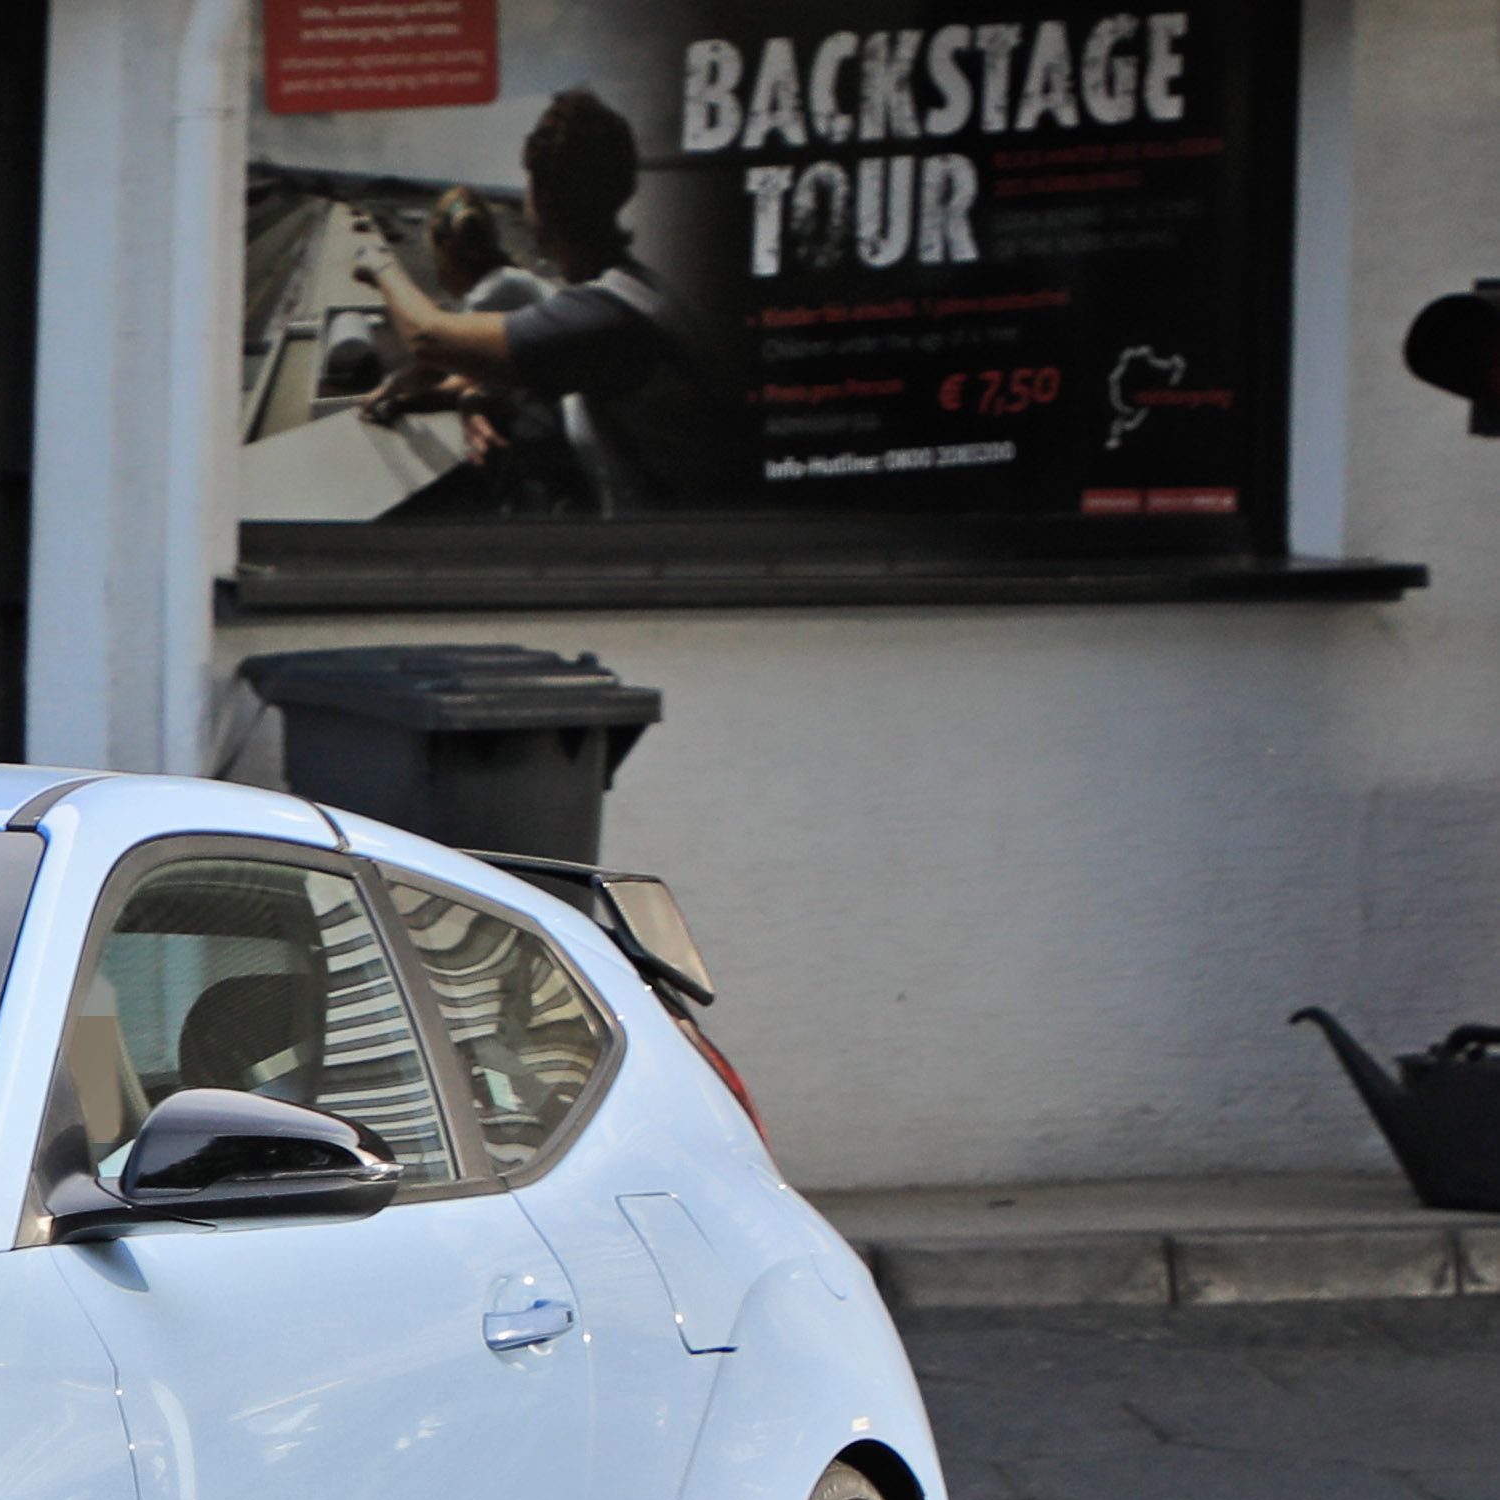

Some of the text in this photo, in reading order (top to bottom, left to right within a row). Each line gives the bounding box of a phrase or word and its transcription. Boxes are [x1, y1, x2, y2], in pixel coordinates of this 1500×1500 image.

[681, 13, 1189, 152] BACKSTAGE
[746, 153, 980, 278] TOUR
[939, 372, 968, 411] €
[977, 366, 1062, 416] 7,50
